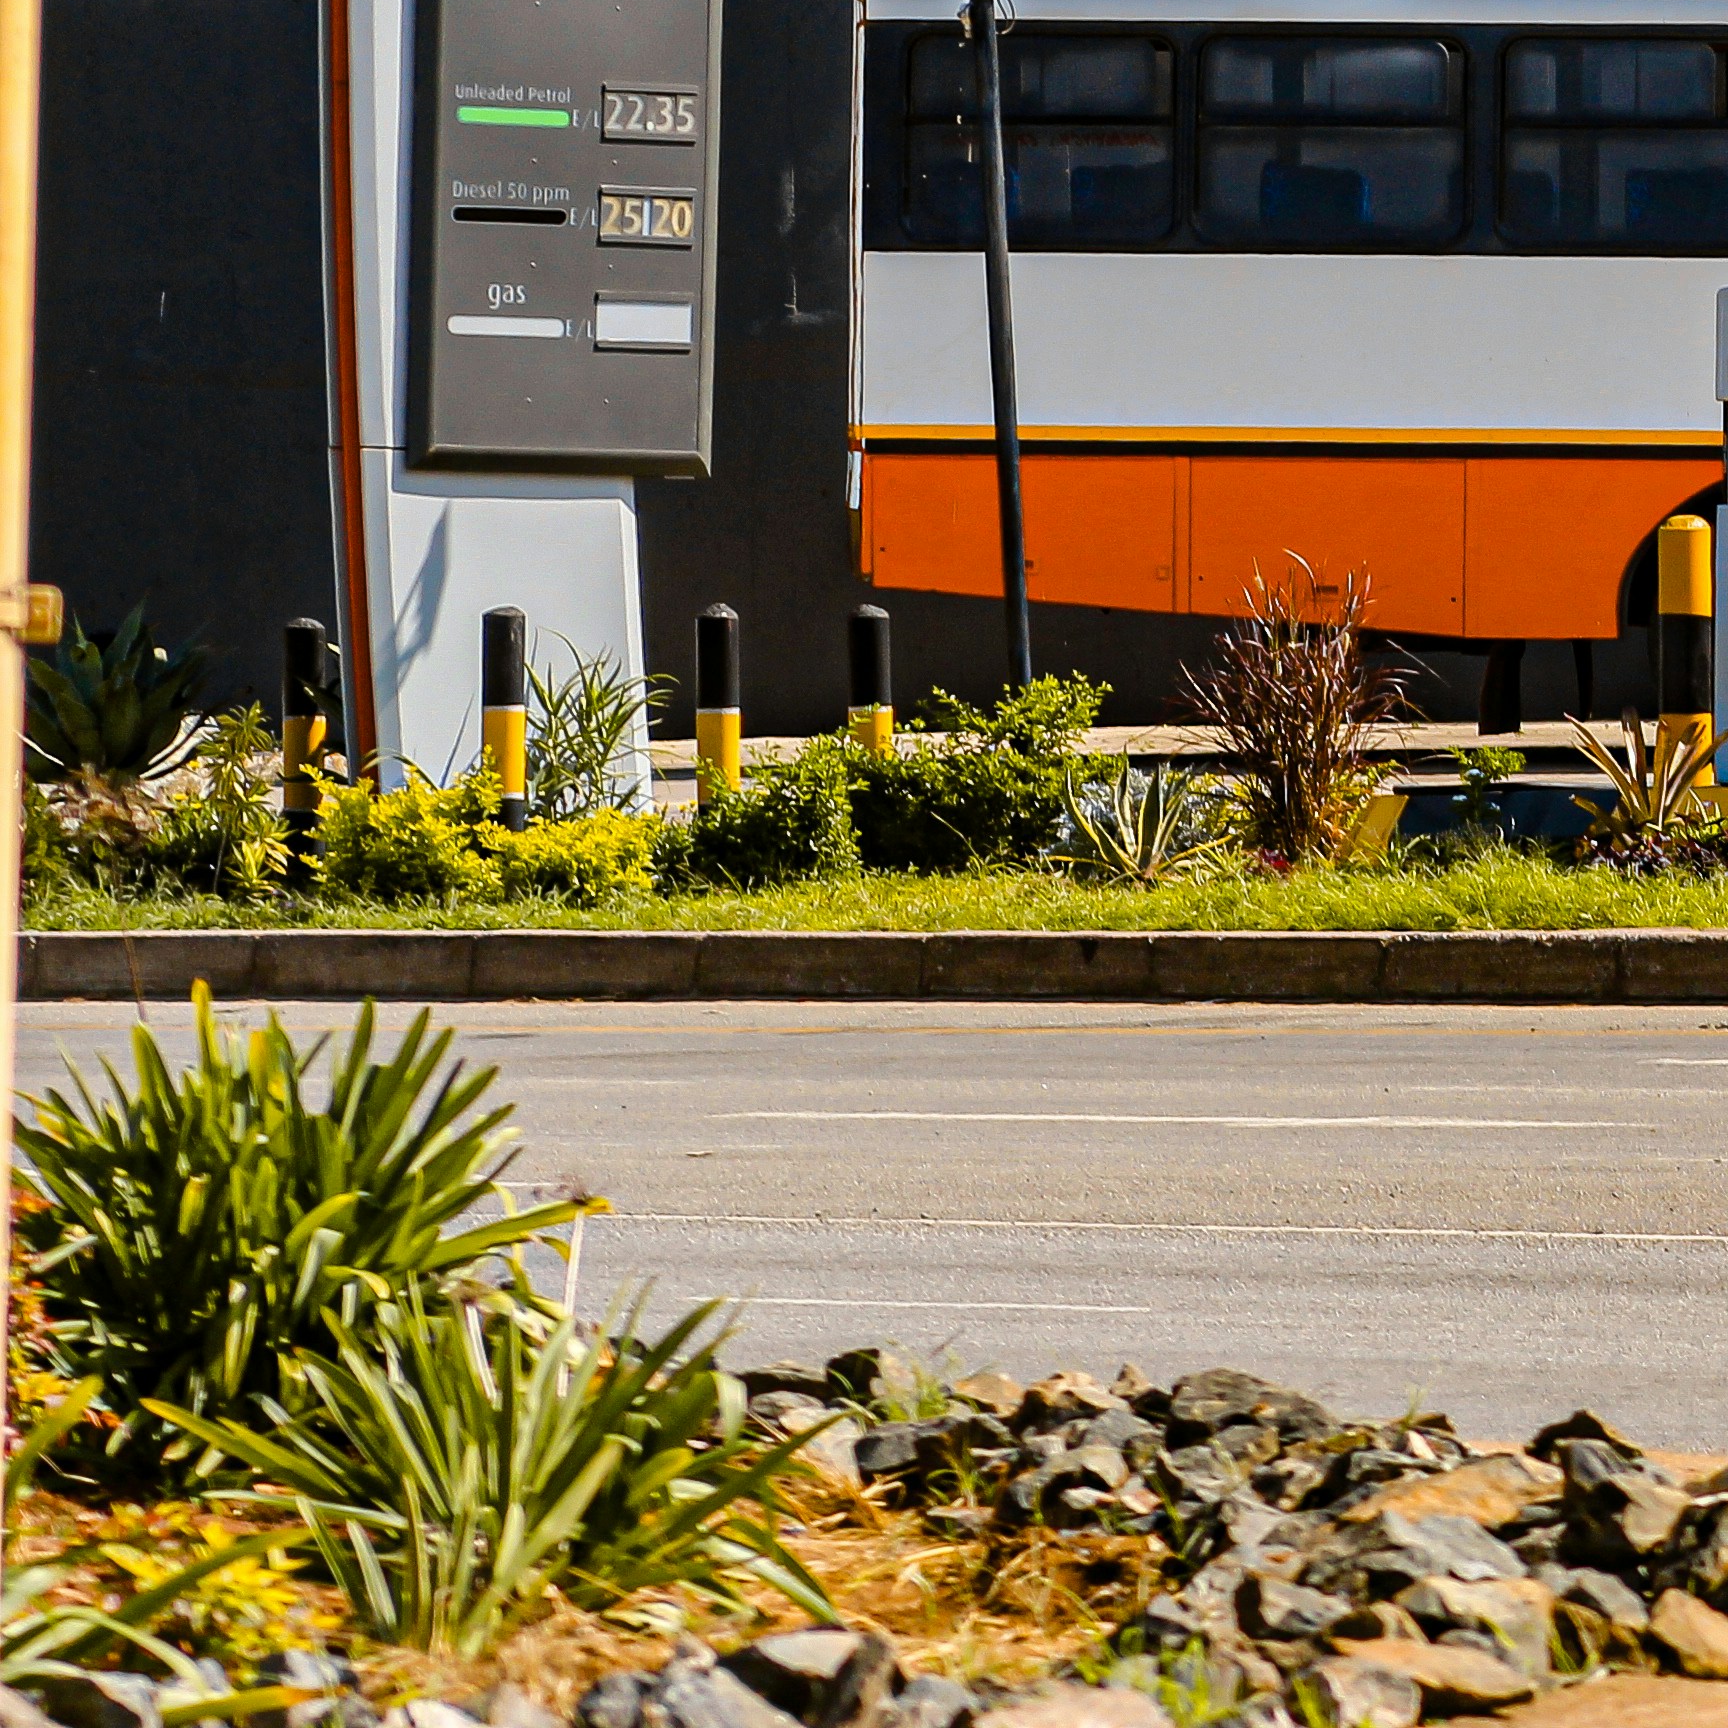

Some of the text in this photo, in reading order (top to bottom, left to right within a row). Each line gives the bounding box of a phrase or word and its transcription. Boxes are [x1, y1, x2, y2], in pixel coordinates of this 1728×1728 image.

[454, 83, 572, 103] Unleaded Petrol
[604, 95, 696, 133] 22.35
[452, 179, 571, 206] Diesel 50 ppm
[487, 283, 528, 310] gas
